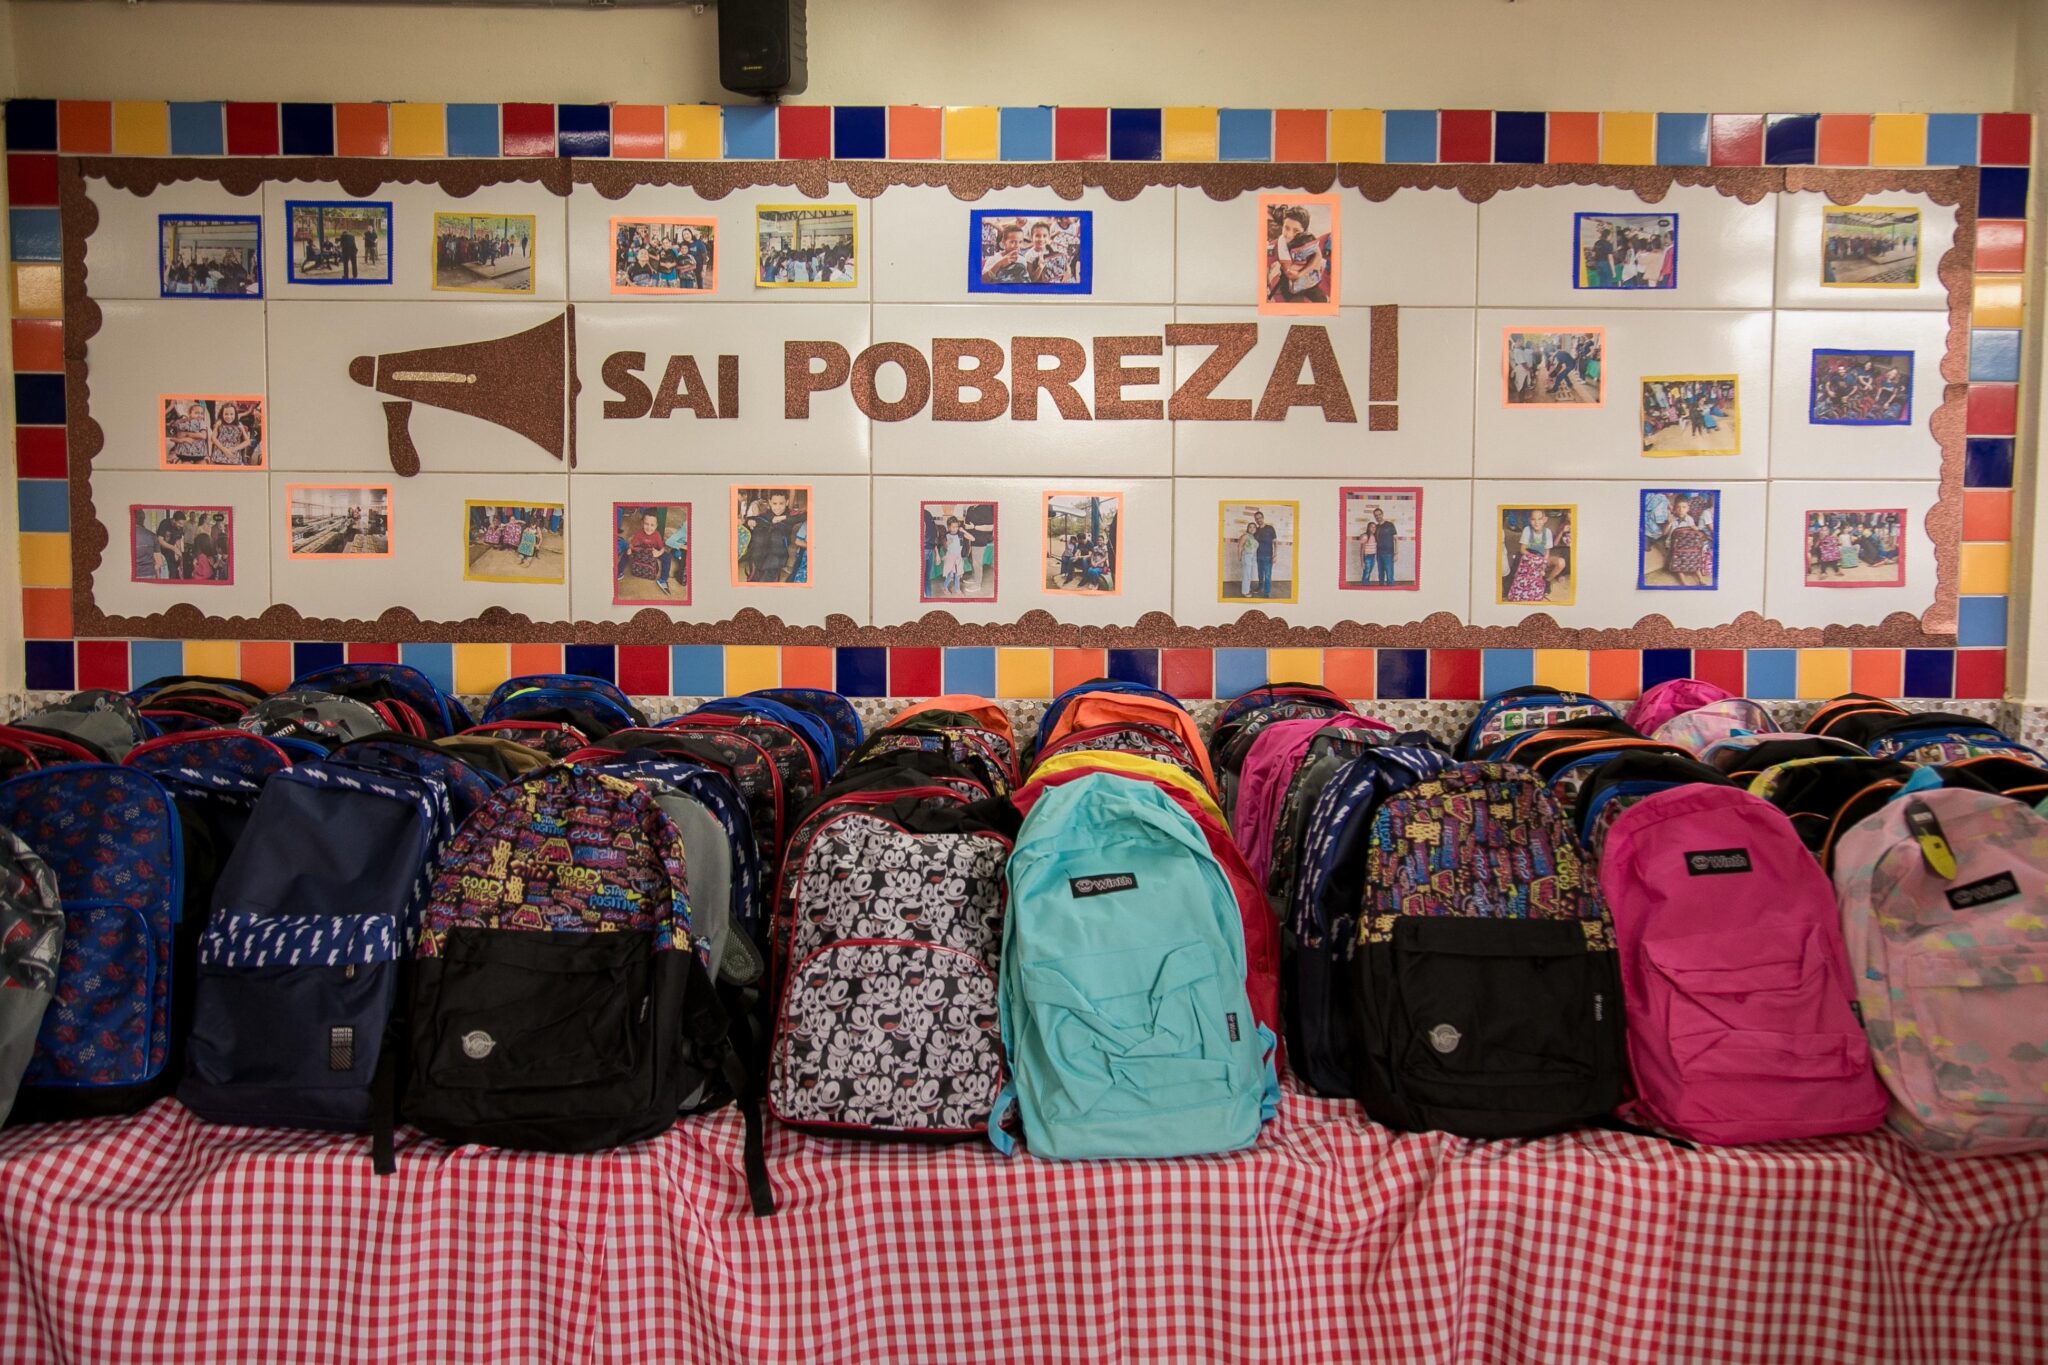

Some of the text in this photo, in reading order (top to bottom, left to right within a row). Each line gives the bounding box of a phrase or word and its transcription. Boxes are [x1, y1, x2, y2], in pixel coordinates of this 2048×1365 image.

[600, 303, 1399, 431] SAI POBREZA!
[570, 829, 610, 842] COOL
[1378, 807, 1393, 851] POSITIVE
[500, 839, 512, 849] DO
[557, 865, 601, 885] GOOD
[1094, 876, 1133, 891] Winth
[462, 875, 504, 894] GOOD
[559, 877, 595, 892] VIBES
[464, 887, 499, 903] VIBES
[588, 893, 640, 914] POSITIVE
